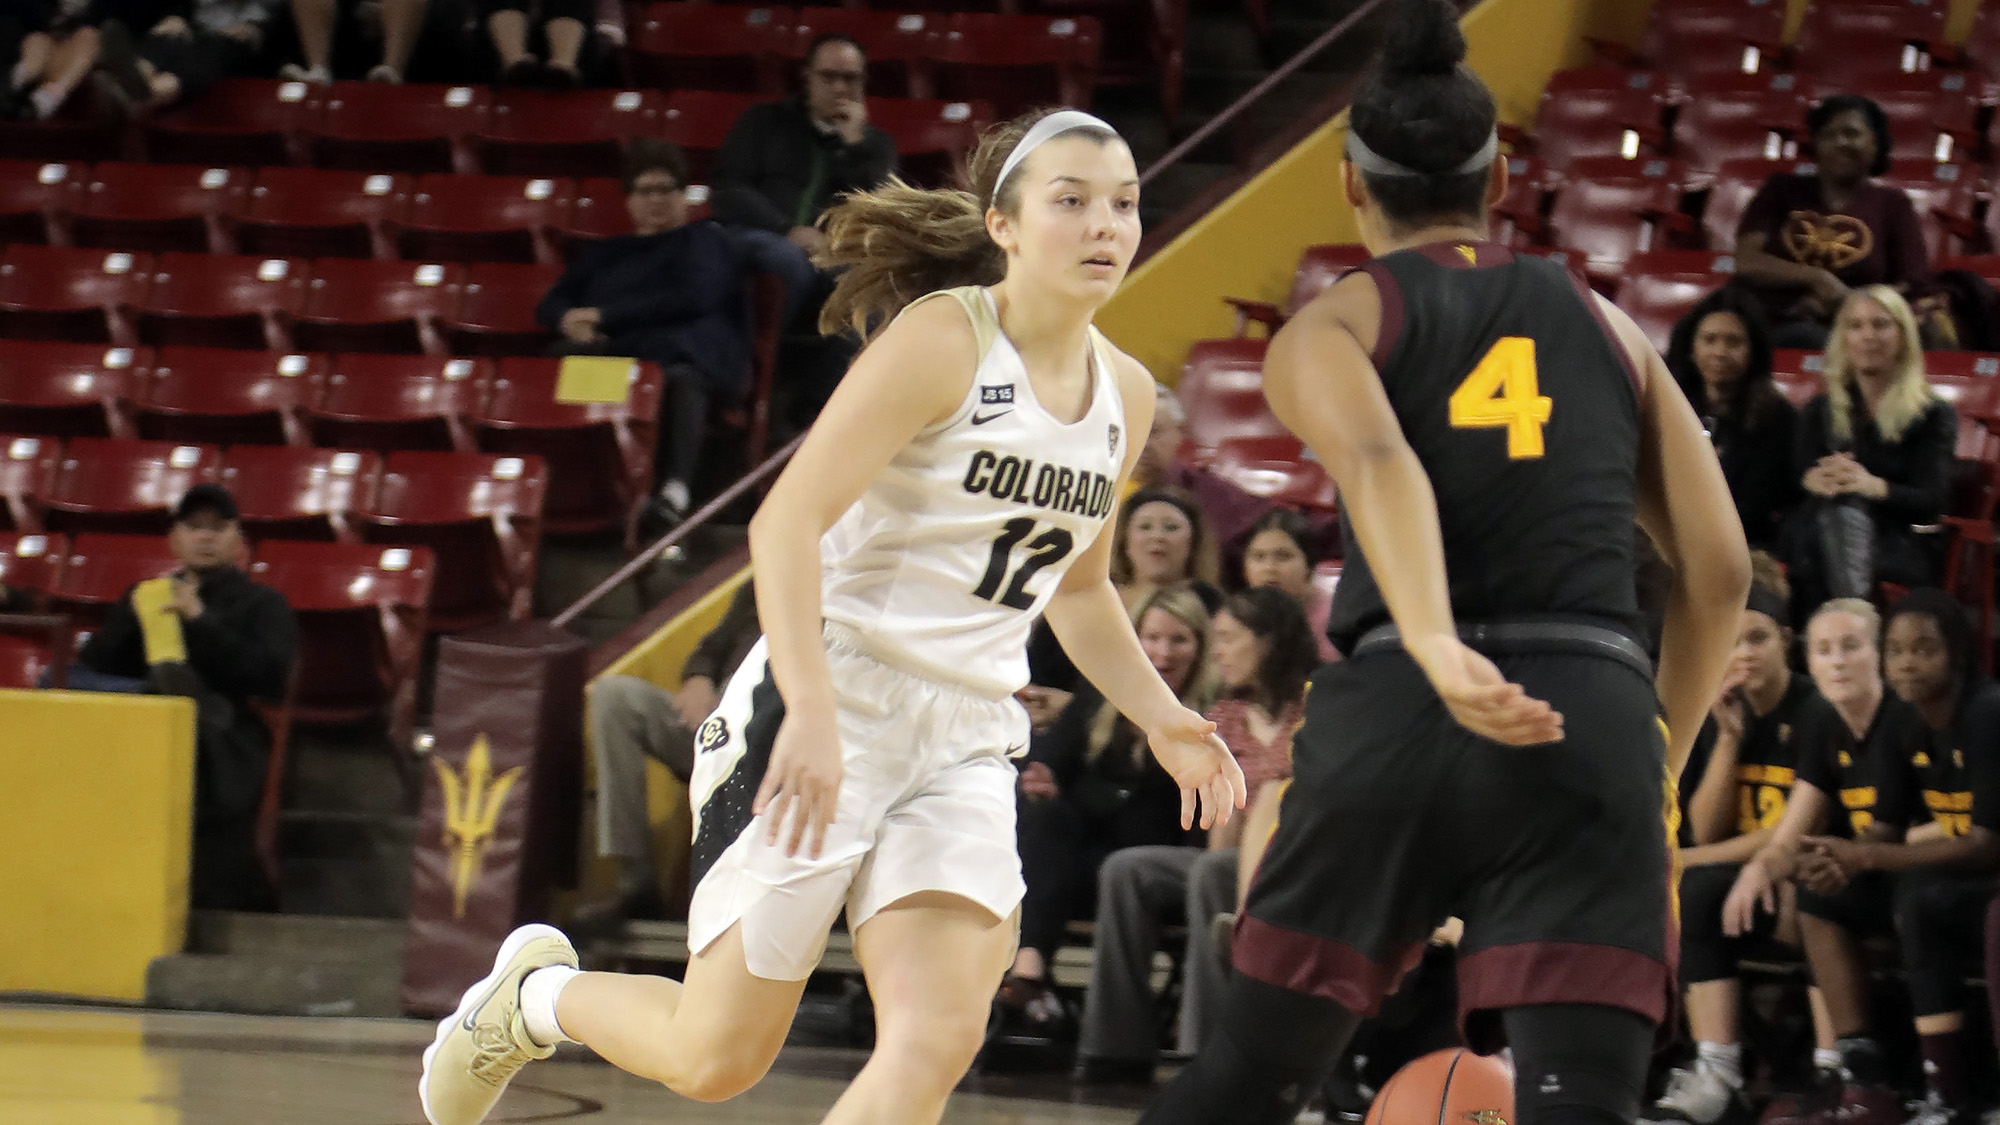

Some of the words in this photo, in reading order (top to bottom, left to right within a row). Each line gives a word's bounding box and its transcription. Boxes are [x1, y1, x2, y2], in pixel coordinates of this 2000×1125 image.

[998, 387, 1013, 400] 15
[1449, 336, 1553, 460] 4
[973, 516, 1074, 611] 12
